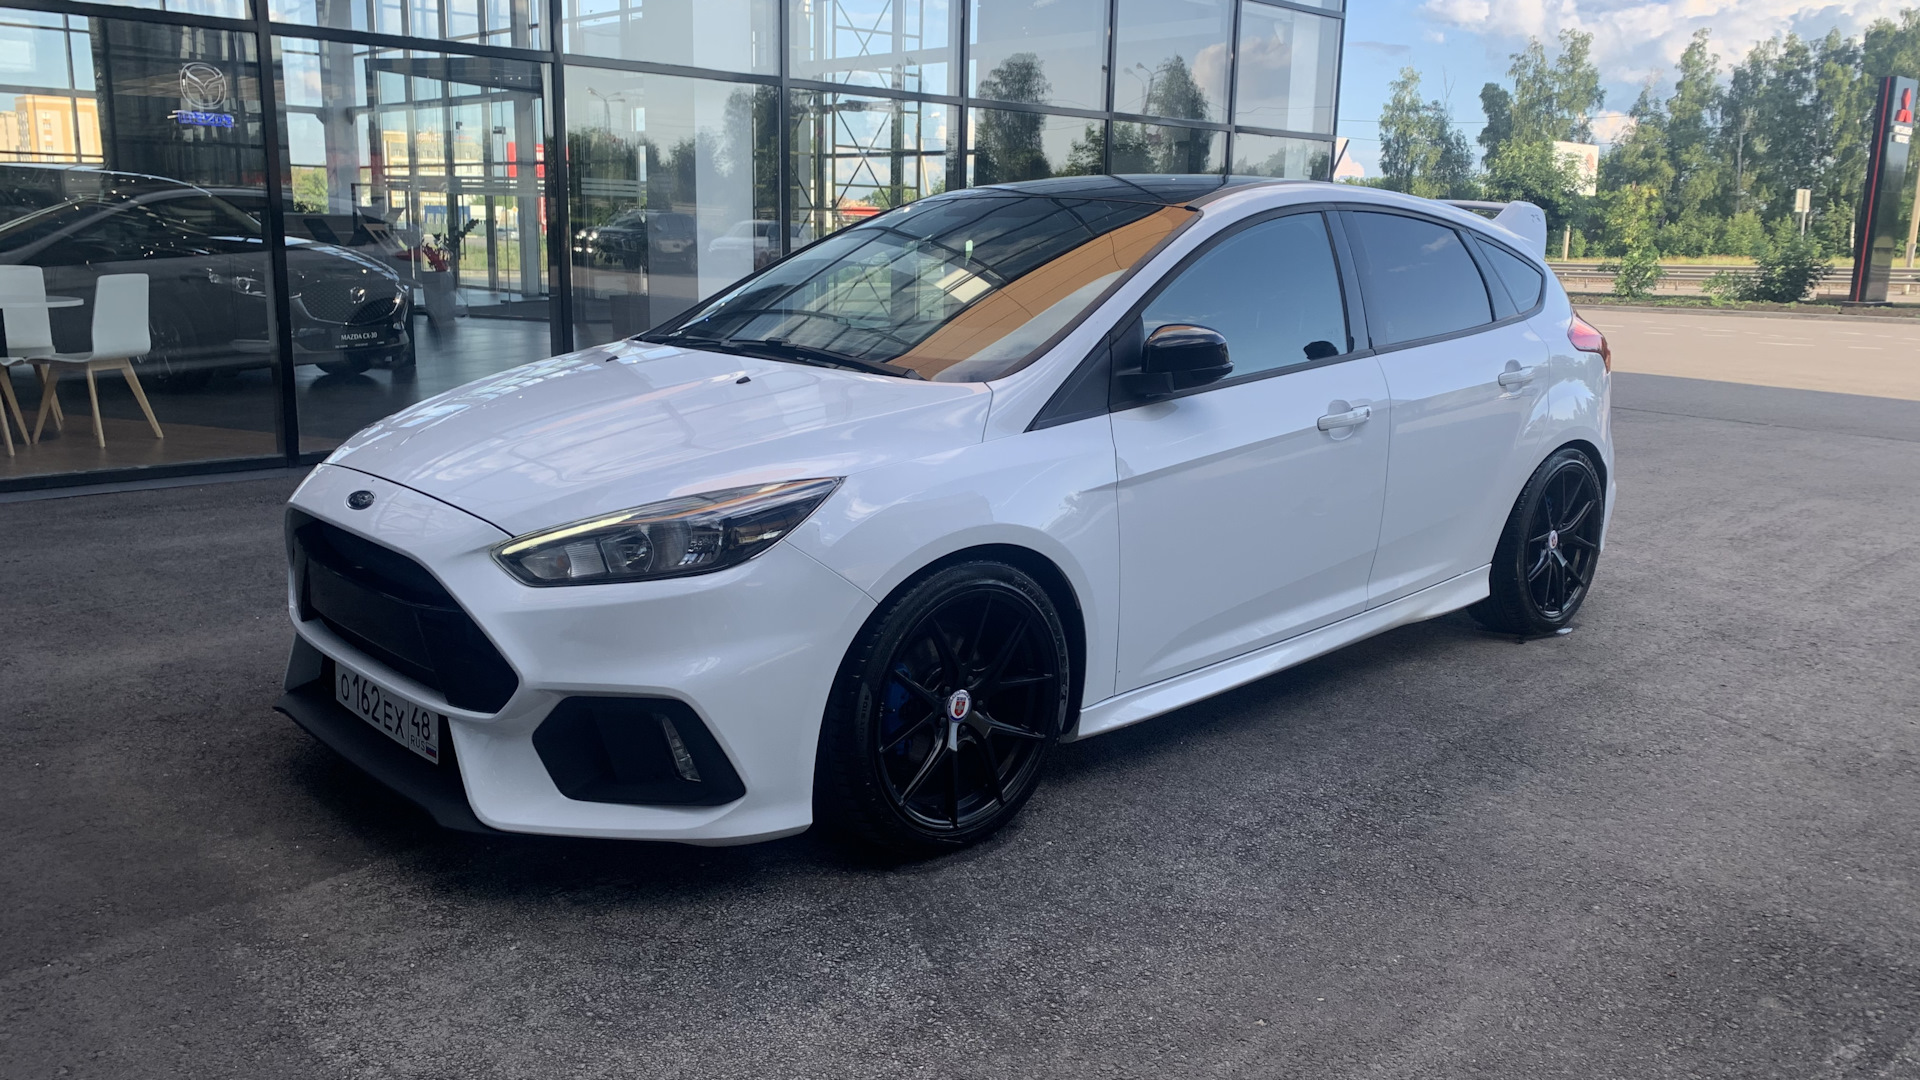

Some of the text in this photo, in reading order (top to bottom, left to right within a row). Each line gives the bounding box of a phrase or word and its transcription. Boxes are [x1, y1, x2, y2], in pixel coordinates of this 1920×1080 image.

[340, 331, 378, 341] MAZDA CX-30
[411, 706, 431, 741] 48
[410, 734, 426, 752] RUS
